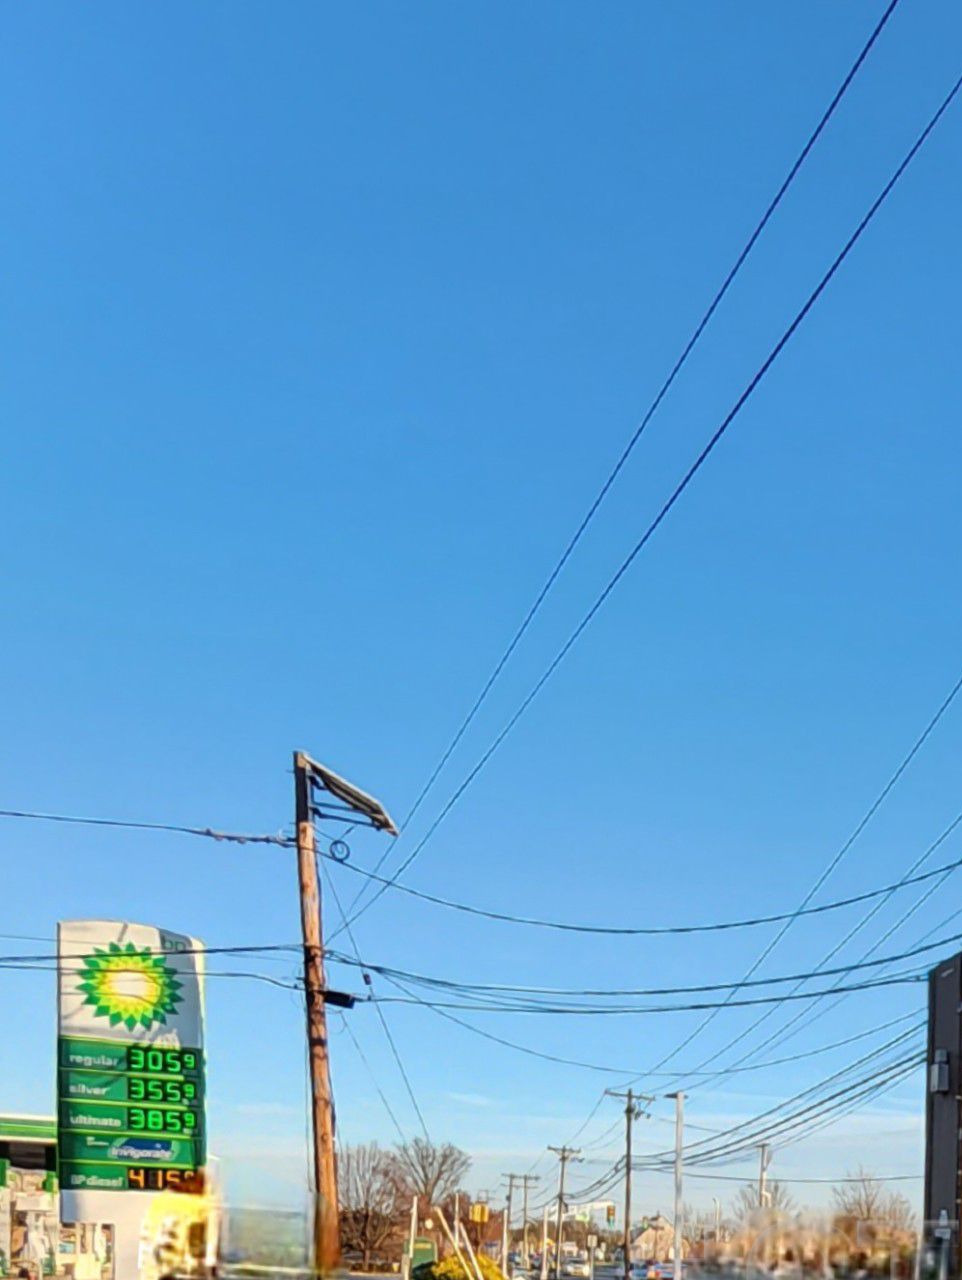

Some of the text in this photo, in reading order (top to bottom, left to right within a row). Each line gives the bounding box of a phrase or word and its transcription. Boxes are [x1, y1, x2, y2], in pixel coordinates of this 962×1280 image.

[69, 1053, 119, 1067] regular
[68, 1083, 111, 1096] silver
[69, 1114, 122, 1128] ultimate
